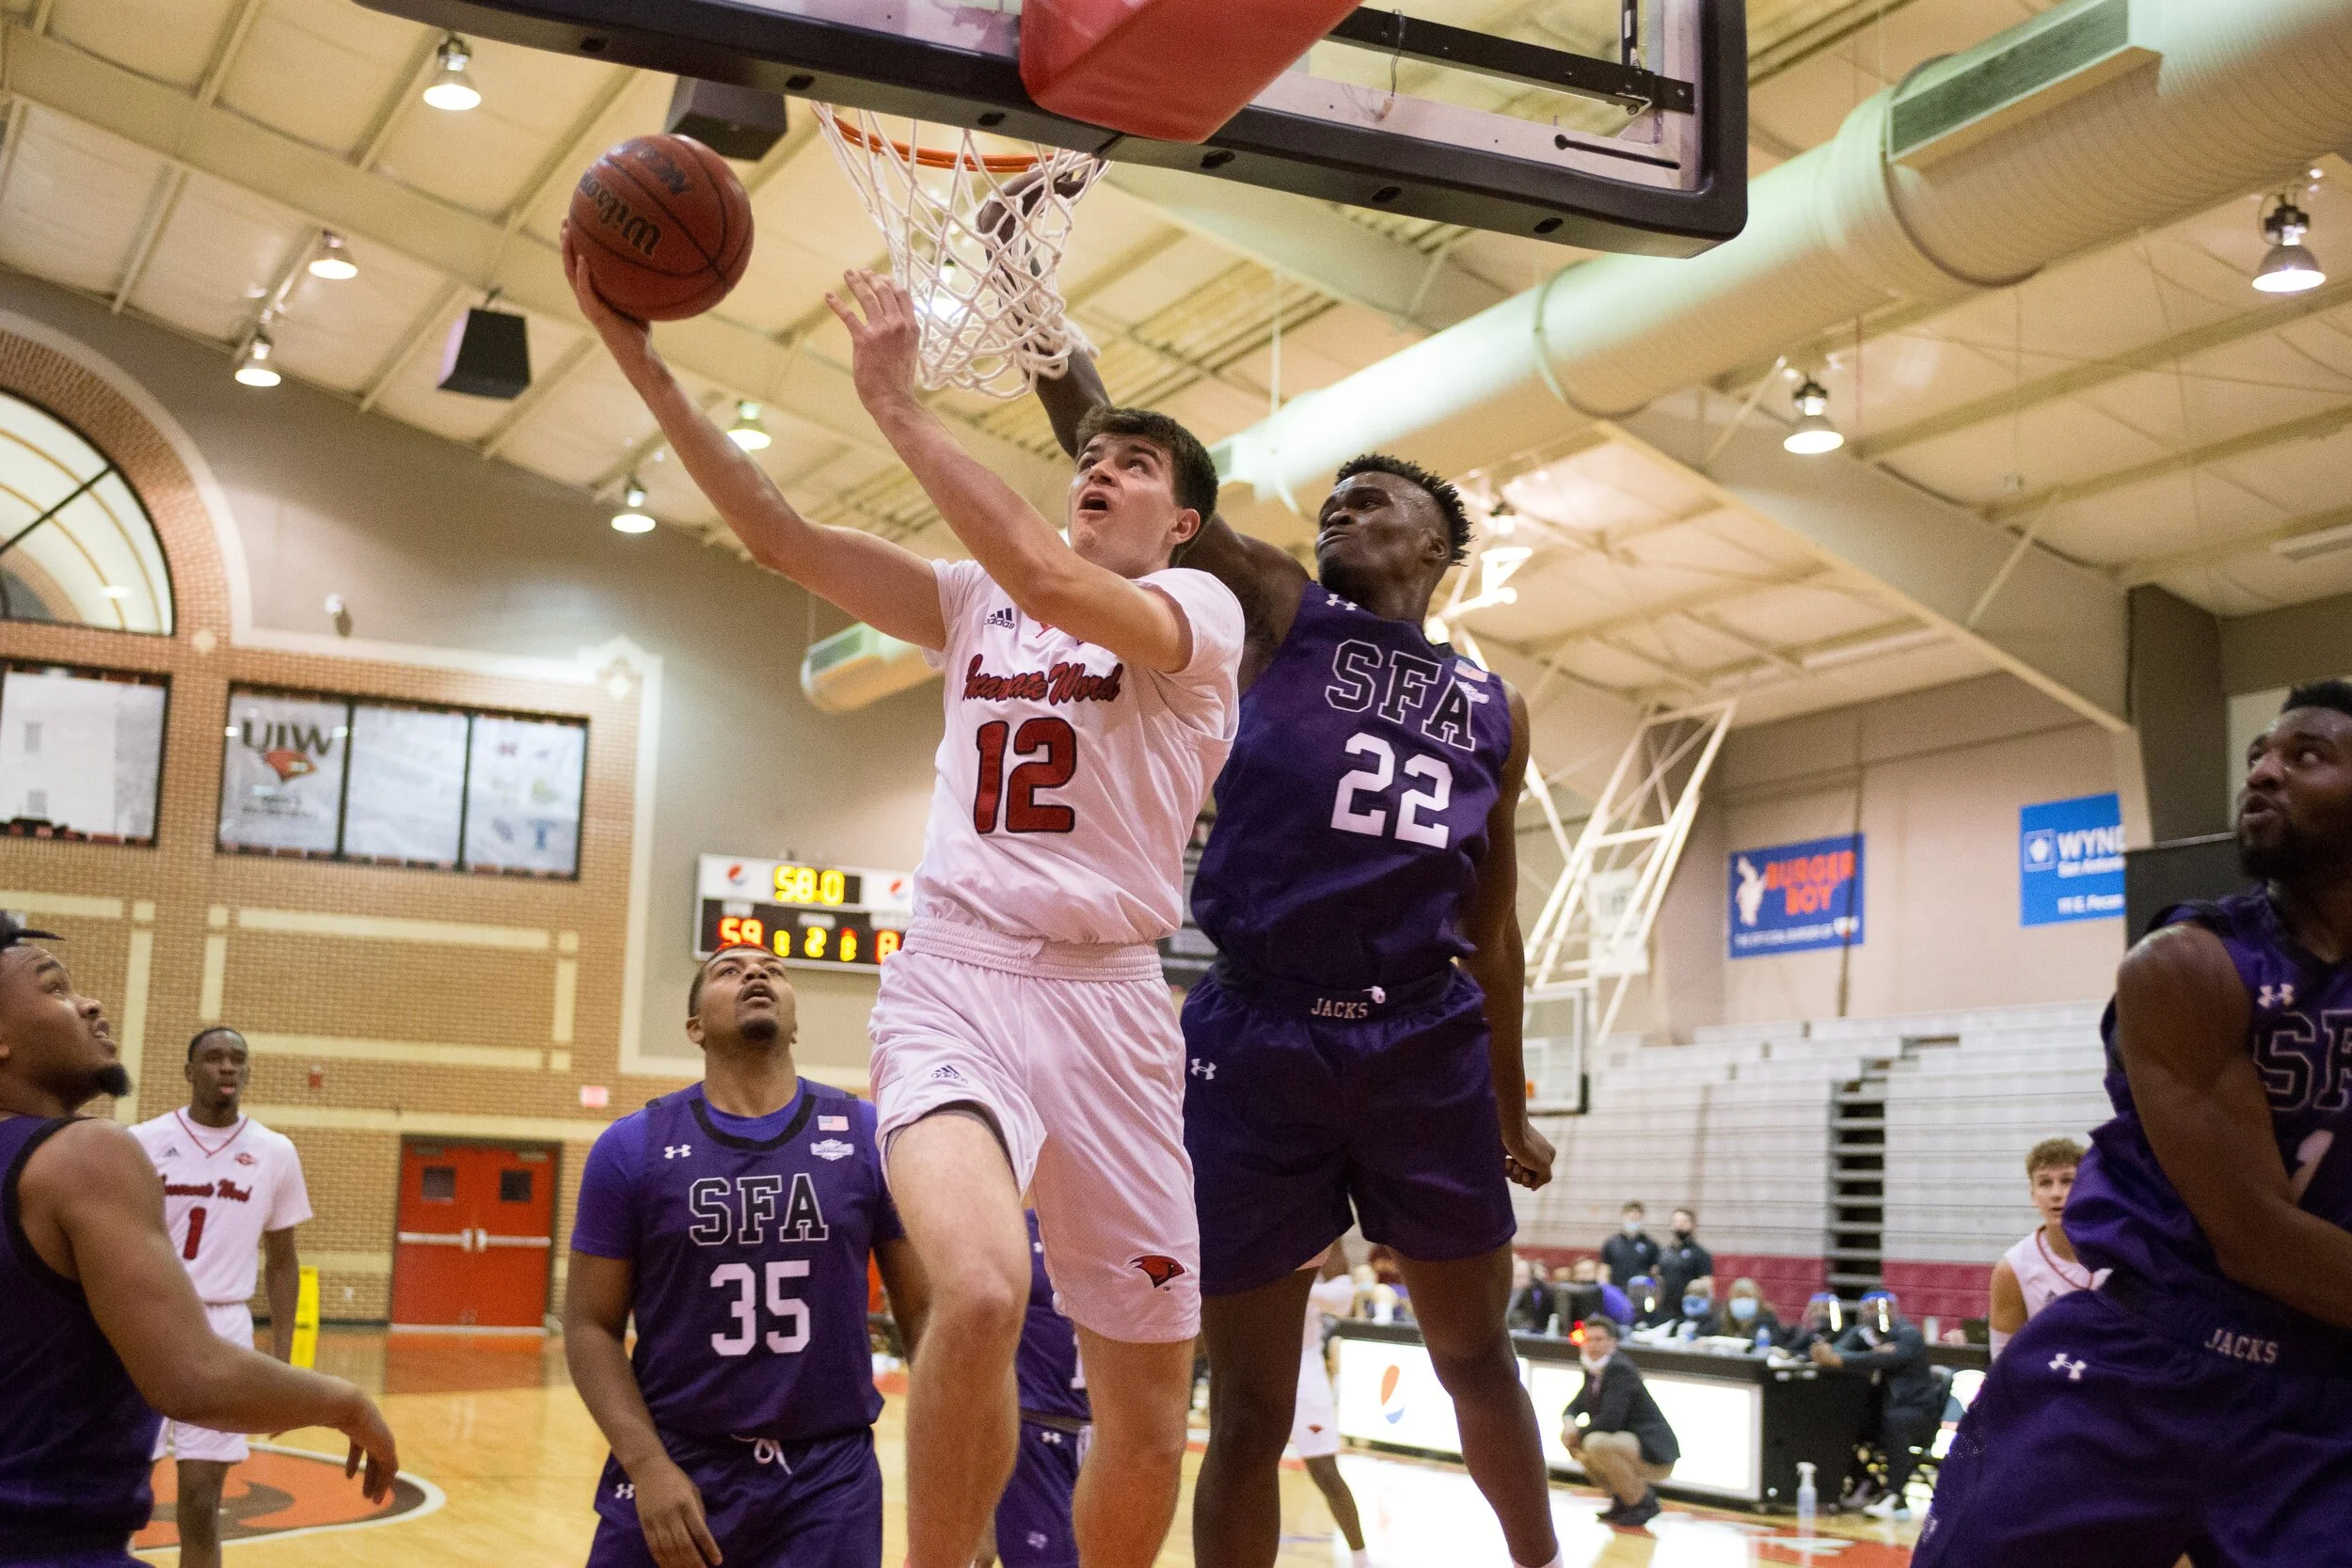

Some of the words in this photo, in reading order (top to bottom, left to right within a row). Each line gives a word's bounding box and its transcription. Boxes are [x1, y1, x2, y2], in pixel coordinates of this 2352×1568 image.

[579, 171, 662, 256] Wilson
[984, 616, 1015, 629] adidas
[1048, 662, 1123, 705] Word
[1325, 639, 1475, 752] SFA
[242, 718, 333, 757] UIW
[974, 717, 1077, 834] 12
[1330, 732, 1454, 848] 22
[1766, 850, 1855, 890] BURGER
[1785, 882, 1832, 915] BOY
[804, 927, 827, 958] 2
[1311, 998, 1368, 1019] JACKS
[690, 1173, 829, 1245] SFA
[183, 1207, 206, 1260] 1
[710, 1259, 811, 1355] 35
[2204, 1328, 2279, 1364] JACKS
